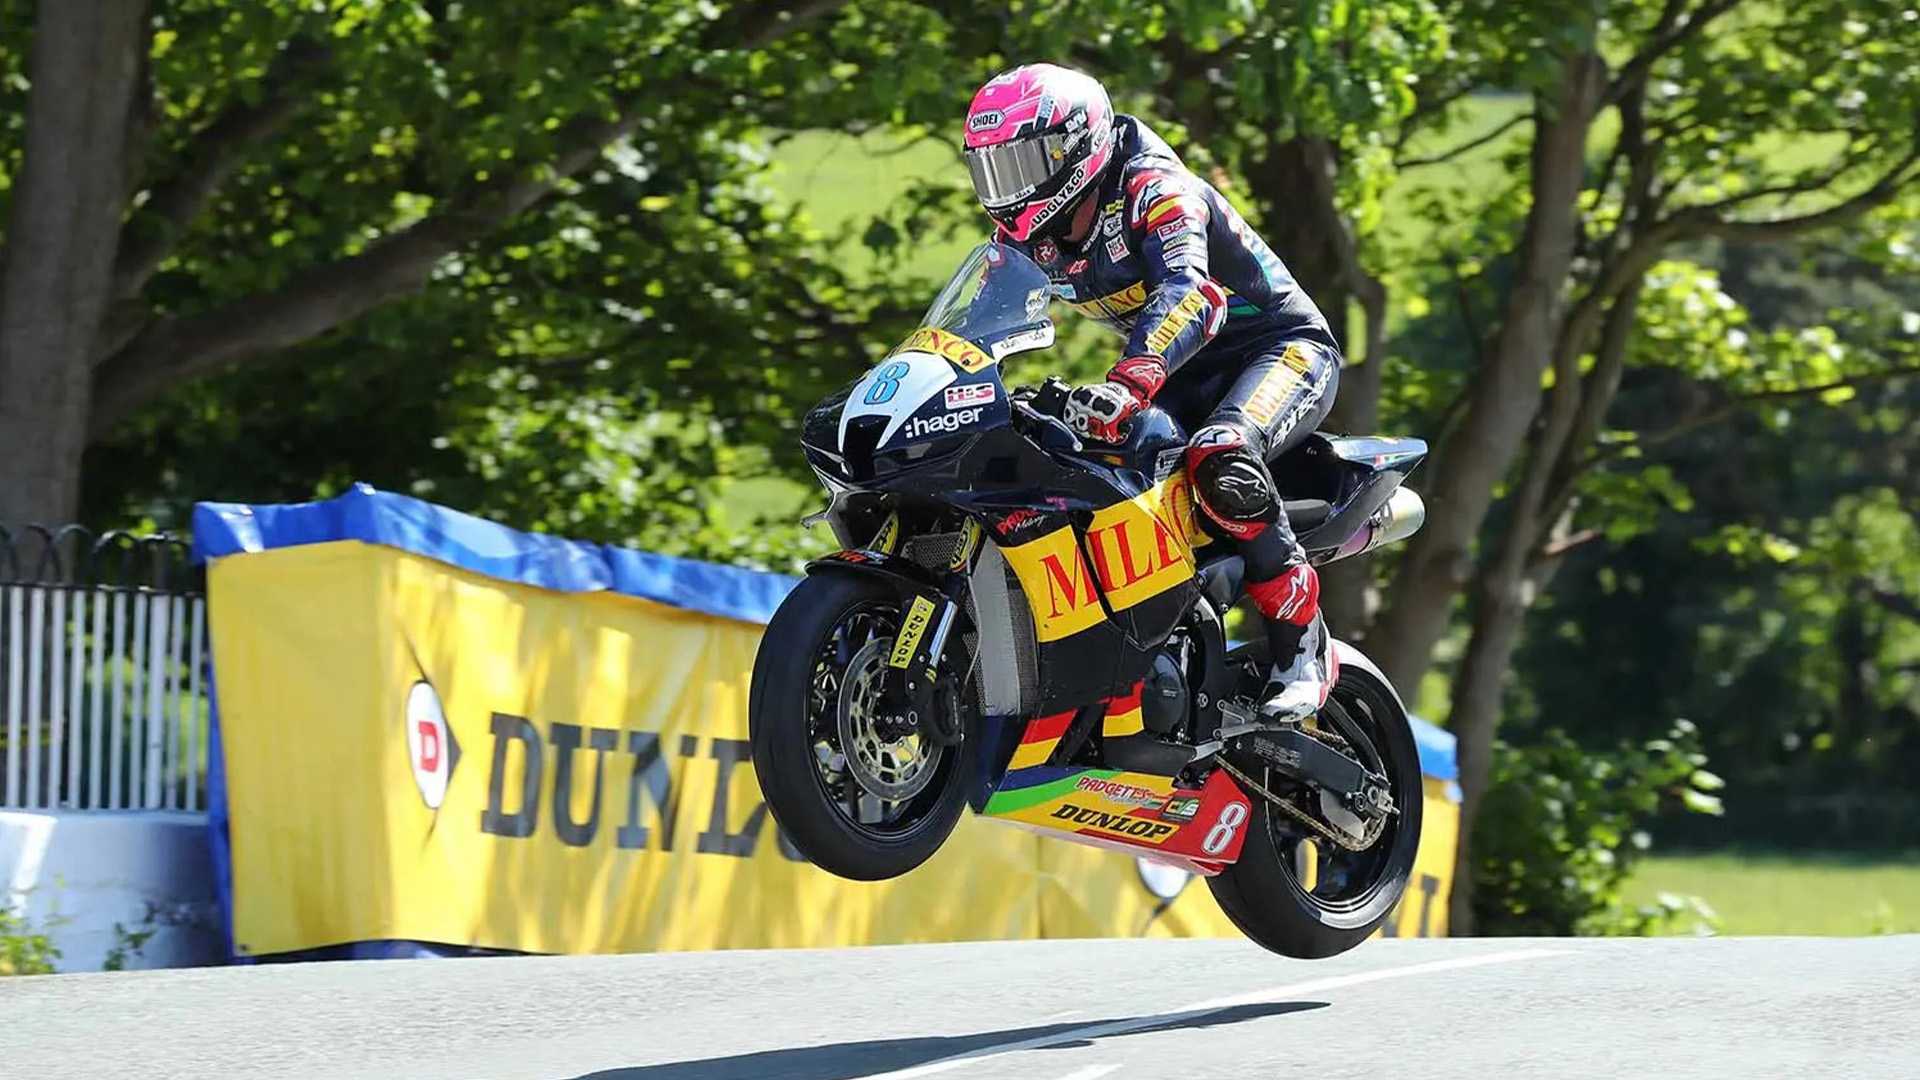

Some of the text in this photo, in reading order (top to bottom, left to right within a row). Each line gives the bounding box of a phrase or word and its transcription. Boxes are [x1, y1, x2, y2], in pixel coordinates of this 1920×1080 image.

[971, 114, 999, 128] SHOEI
[864, 361, 910, 405] 8
[418, 720, 440, 773] D
[480, 711, 809, 863] DUNL
[1051, 803, 1173, 844] DUNLOP
[1203, 801, 1250, 854] 8
